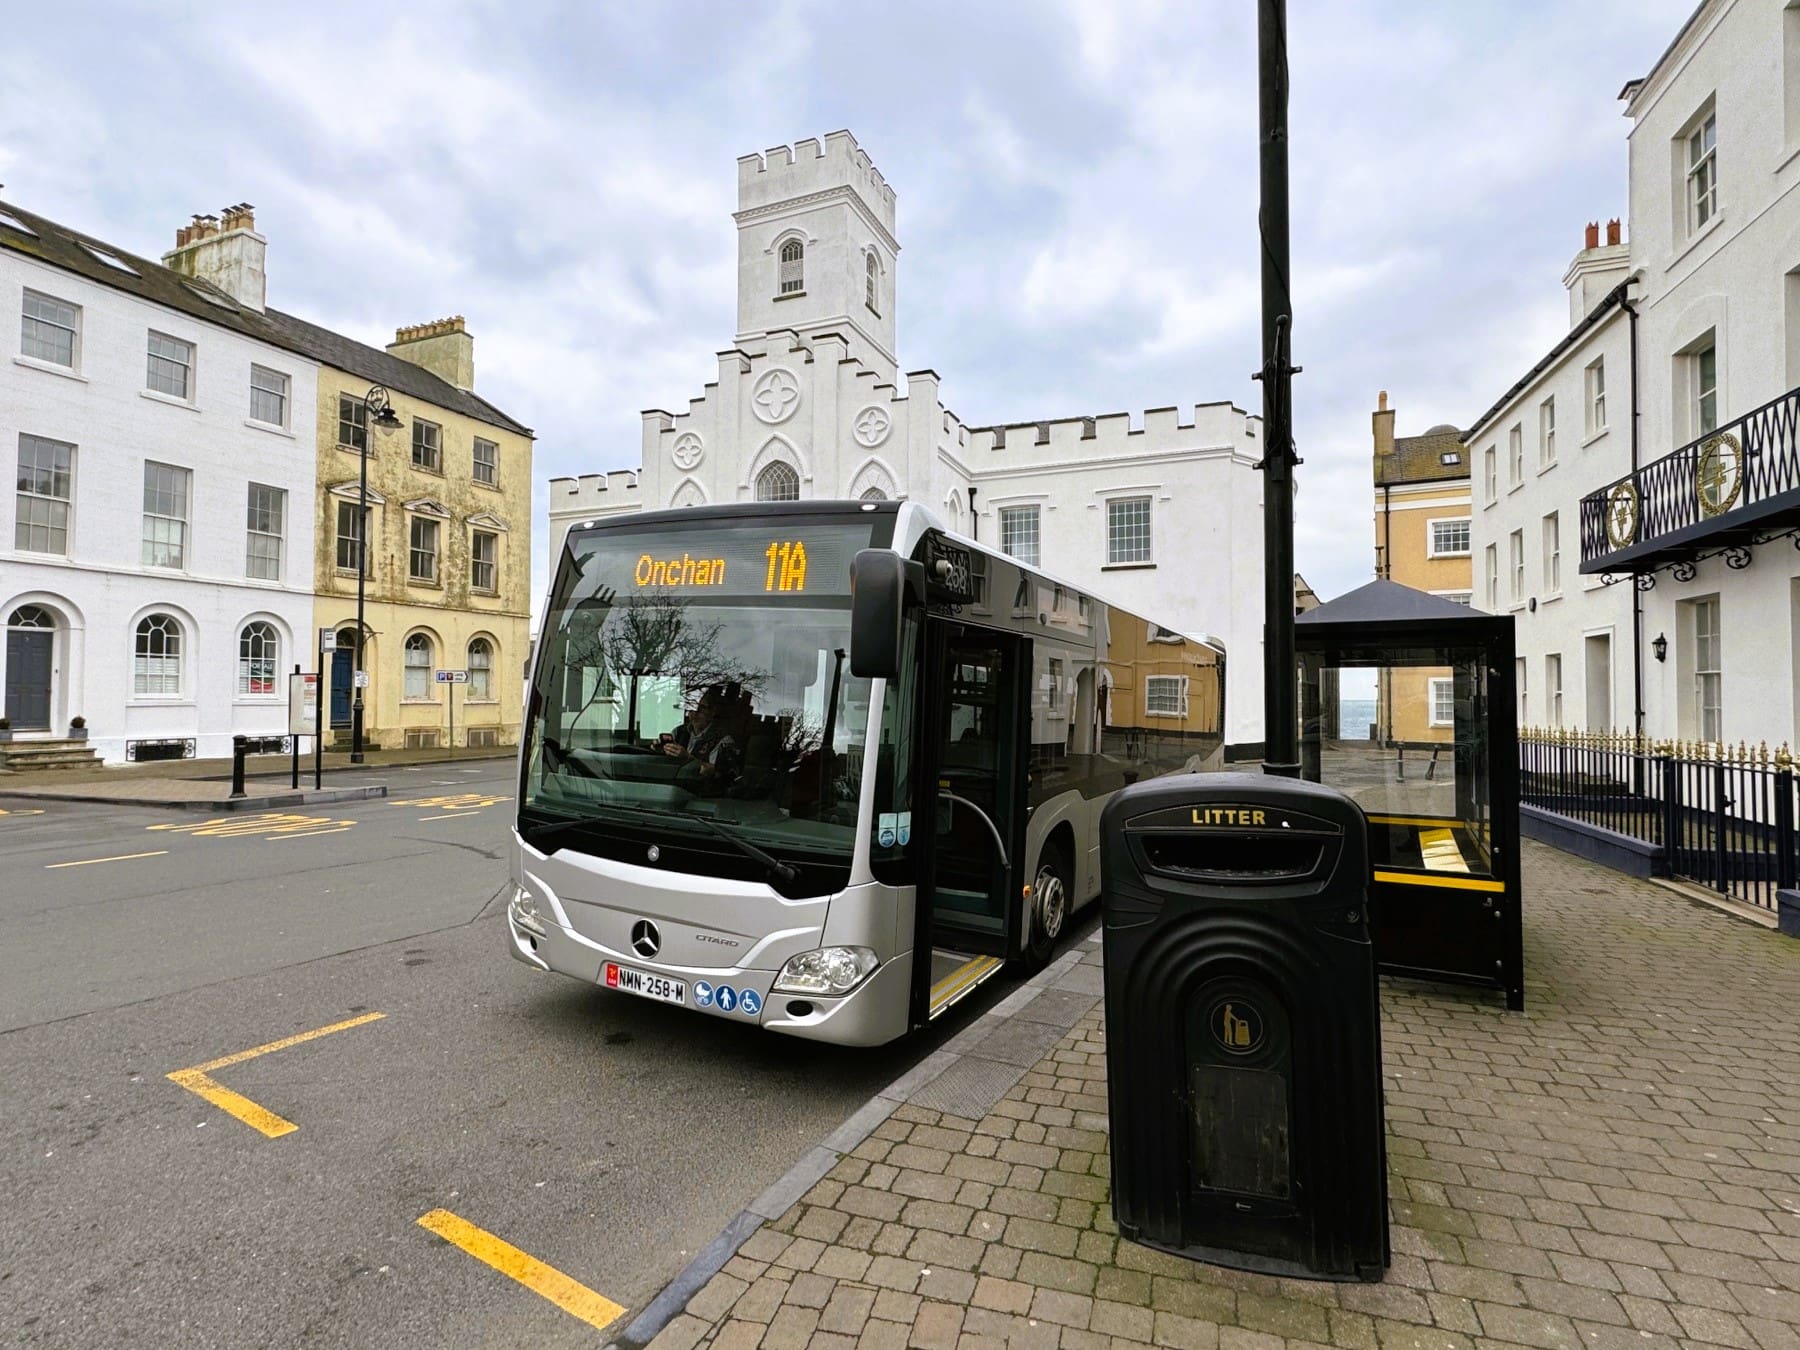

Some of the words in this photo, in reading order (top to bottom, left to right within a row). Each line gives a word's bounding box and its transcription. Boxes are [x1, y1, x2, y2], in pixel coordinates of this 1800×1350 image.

[635, 553, 725, 586] Onchan
[765, 541, 807, 591] 11A
[1192, 809, 1266, 825] LITTER
[696, 934, 739, 947] CITARO
[619, 970, 684, 1001] NMN-258-M
